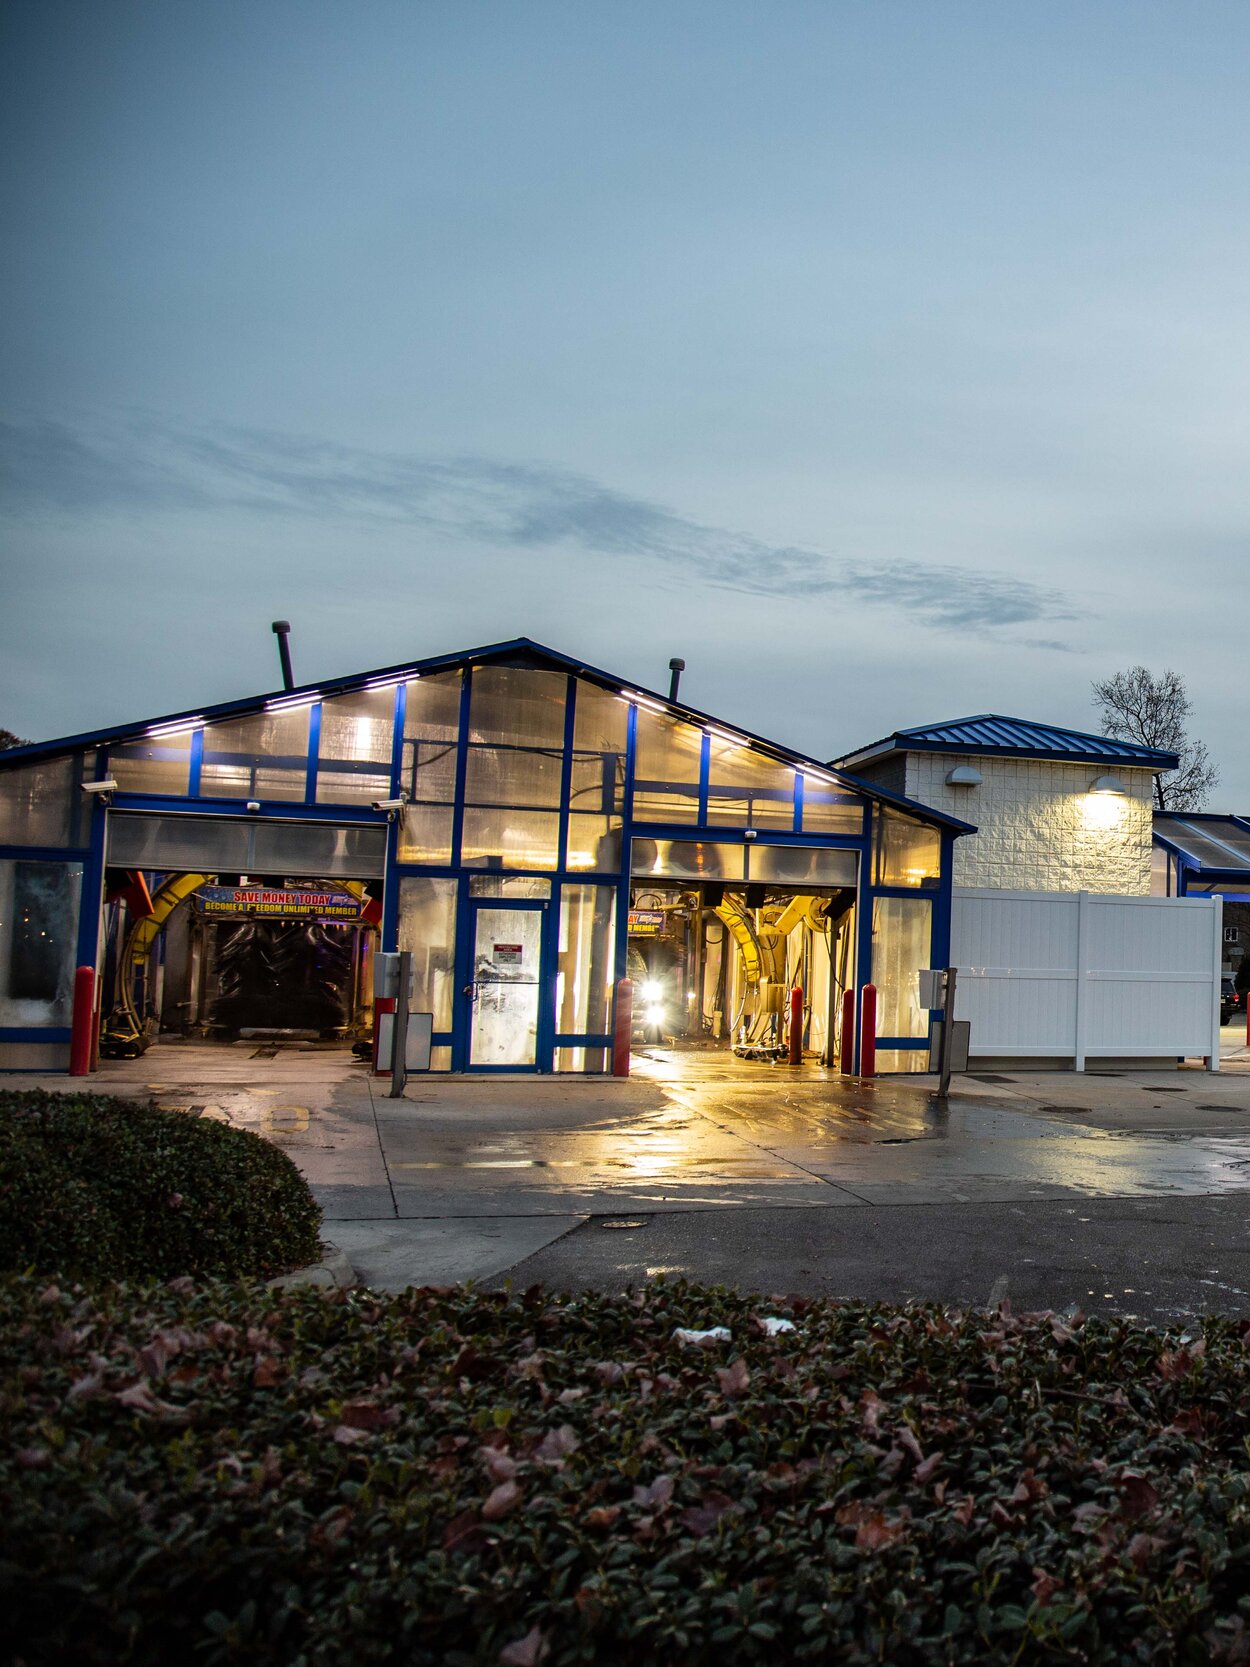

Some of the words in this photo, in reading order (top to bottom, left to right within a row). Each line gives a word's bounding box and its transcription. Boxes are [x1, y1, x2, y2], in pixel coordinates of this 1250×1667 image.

[234, 891, 259, 903] SAVE
[262, 892, 297, 904] MONEY
[298, 894, 331, 905] TODAY
[205, 902, 237, 911] BECOME
[238, 903, 243, 911] A
[325, 906, 357, 916] MEMBER
